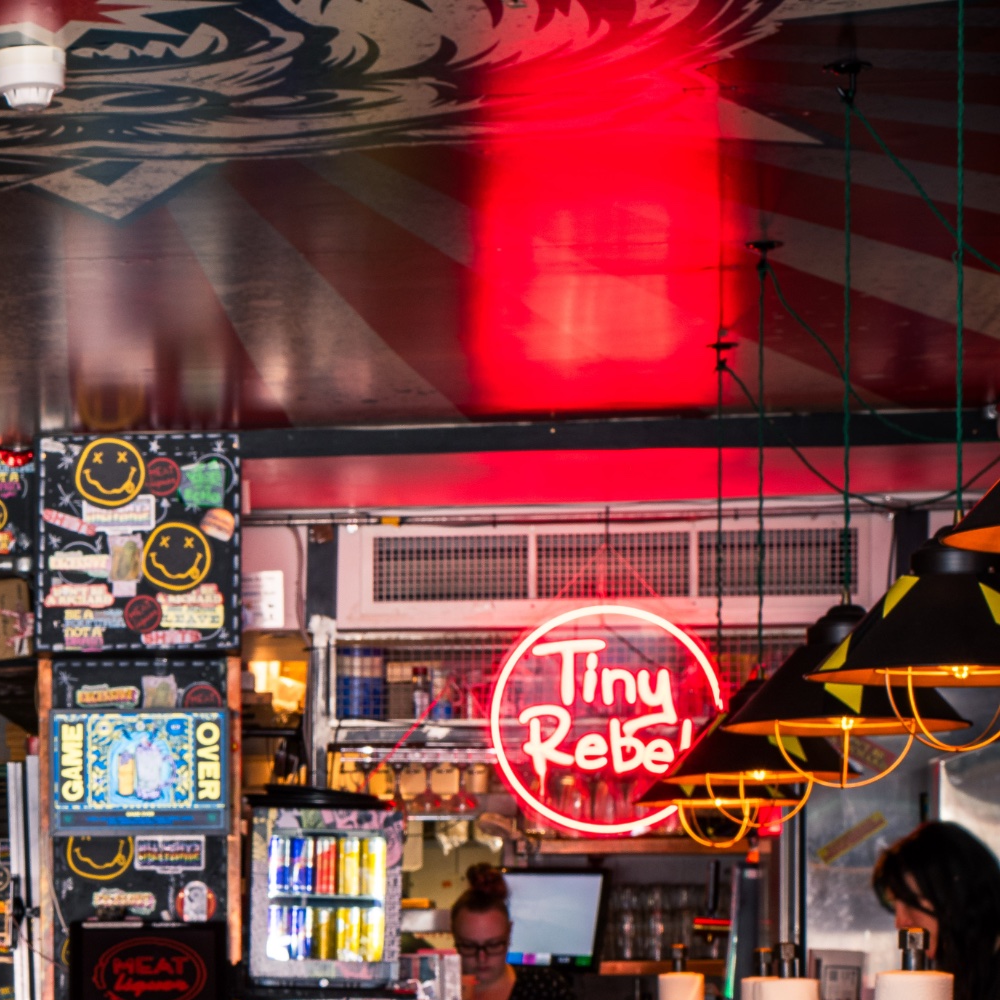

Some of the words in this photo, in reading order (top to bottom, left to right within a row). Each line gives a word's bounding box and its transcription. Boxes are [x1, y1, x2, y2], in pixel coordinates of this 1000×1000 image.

[532, 639, 677, 735] Tiny
[60, 722, 85, 802] GAME
[195, 721, 221, 800] OVER
[519, 705, 692, 787] Rebel
[111, 956, 190, 975] MEAT
